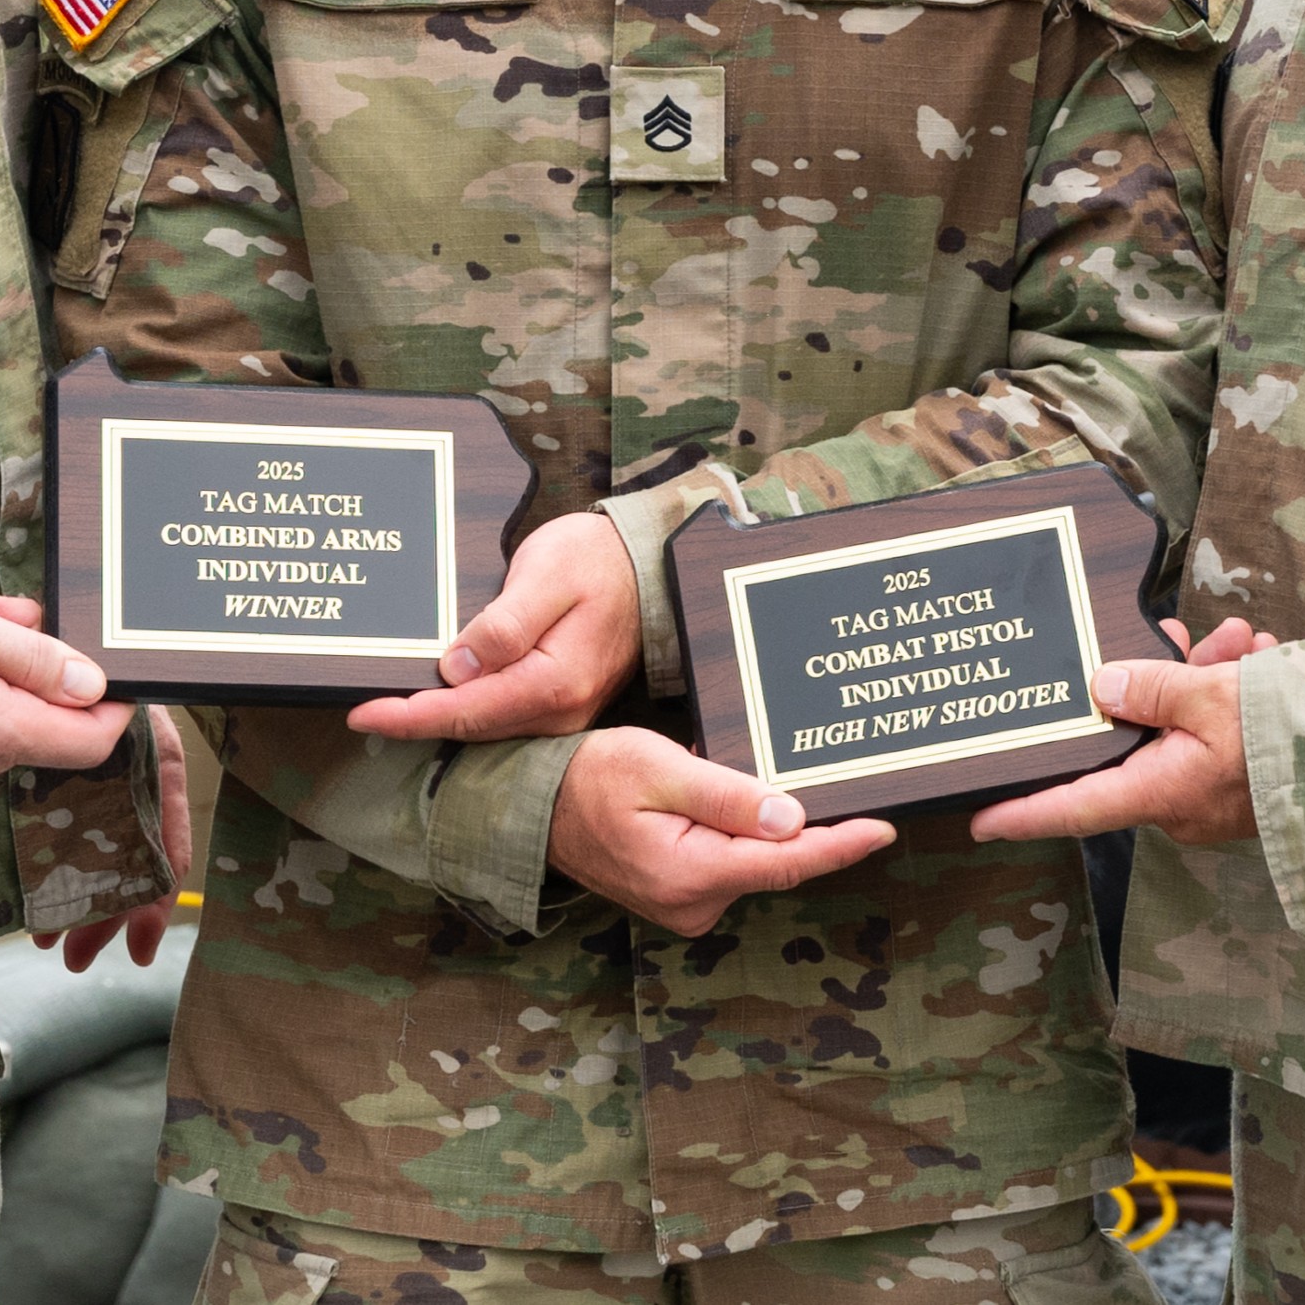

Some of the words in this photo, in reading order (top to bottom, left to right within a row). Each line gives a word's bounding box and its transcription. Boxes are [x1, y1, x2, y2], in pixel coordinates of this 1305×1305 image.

[257, 461, 303, 479] 2025
[200, 491, 255, 512] TAG
[263, 492, 361, 515] MATCH
[160, 523, 313, 548] COMBINED
[321, 529, 401, 551] ARMS
[196, 559, 365, 583] INDIVIDUAL
[882, 568, 930, 592] 2025
[224, 595, 342, 619] WINNER
[831, 607, 889, 637] TAG
[893, 588, 994, 627] MATCH
[804, 635, 923, 677] COMBAT
[934, 617, 1032, 655] PISTOL
[839, 656, 1009, 707] INDIVIDUAL
[792, 722, 864, 752] HIGH
[870, 705, 935, 736] NEW
[939, 680, 1070, 724] SHOOTER
